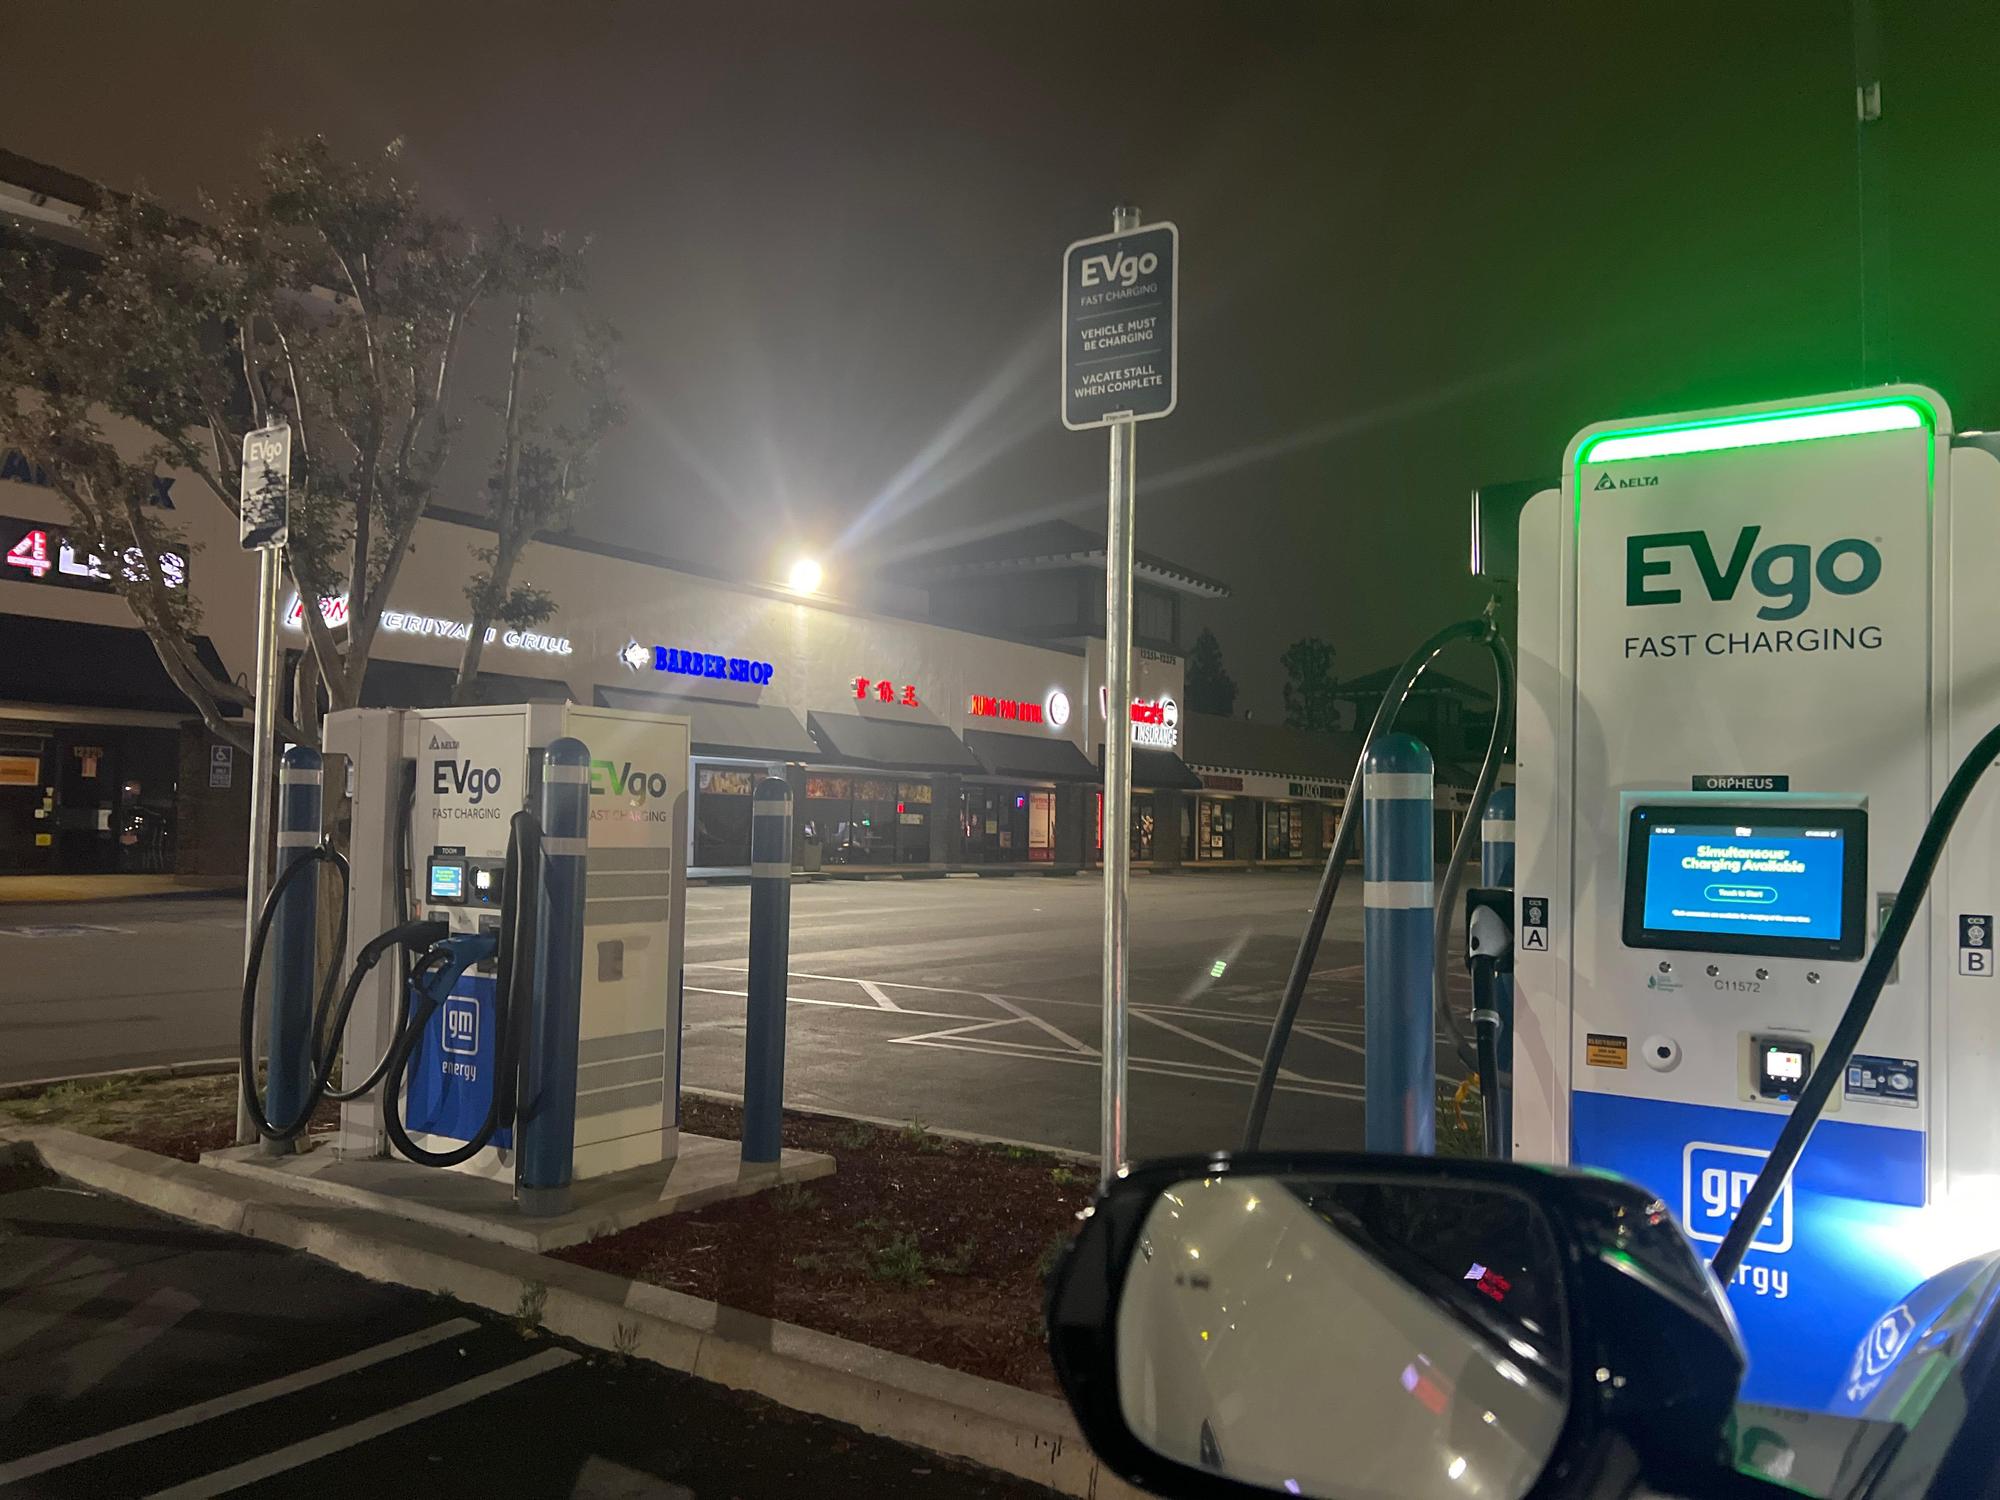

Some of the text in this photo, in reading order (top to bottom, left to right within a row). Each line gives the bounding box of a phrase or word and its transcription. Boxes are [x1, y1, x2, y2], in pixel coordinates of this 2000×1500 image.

[1082, 251, 1158, 287] EVgo
[1081, 283, 1158, 306] FAST CHARGING
[1081, 317, 1157, 339] VEHICLE MUST
[1084, 330, 1153, 351] BE CHARGING
[1082, 364, 1155, 385] VACATE STALL
[1075, 375, 1163, 398] WHEN COMPLETE
[250, 440, 282, 462] EVgo
[1619, 476, 1659, 489] DELTA
[1626, 525, 1882, 621] EVgo
[381, 610, 496, 643] ERIYAI
[504, 631, 573, 653] GRILL
[1625, 626, 1883, 659] FAST CHARGING
[654, 645, 774, 685] BARBER SHOP
[971, 694, 997, 718] KUNG
[1131, 724, 1178, 746] INSURANCE
[433, 760, 501, 804] EVgo
[589, 760, 667, 808] EVgo
[1706, 777, 1774, 789] ORPHEUS
[432, 807, 501, 820] FAST CHARGING
[589, 809, 609, 821] AST
[1681, 856, 1806, 873] Charging Available
[1527, 929, 1543, 947] A
[1968, 952, 1985, 971] B
[1714, 980, 1761, 993] C11572
[449, 1010, 473, 1040] gm
[442, 1060, 477, 1082] energy
